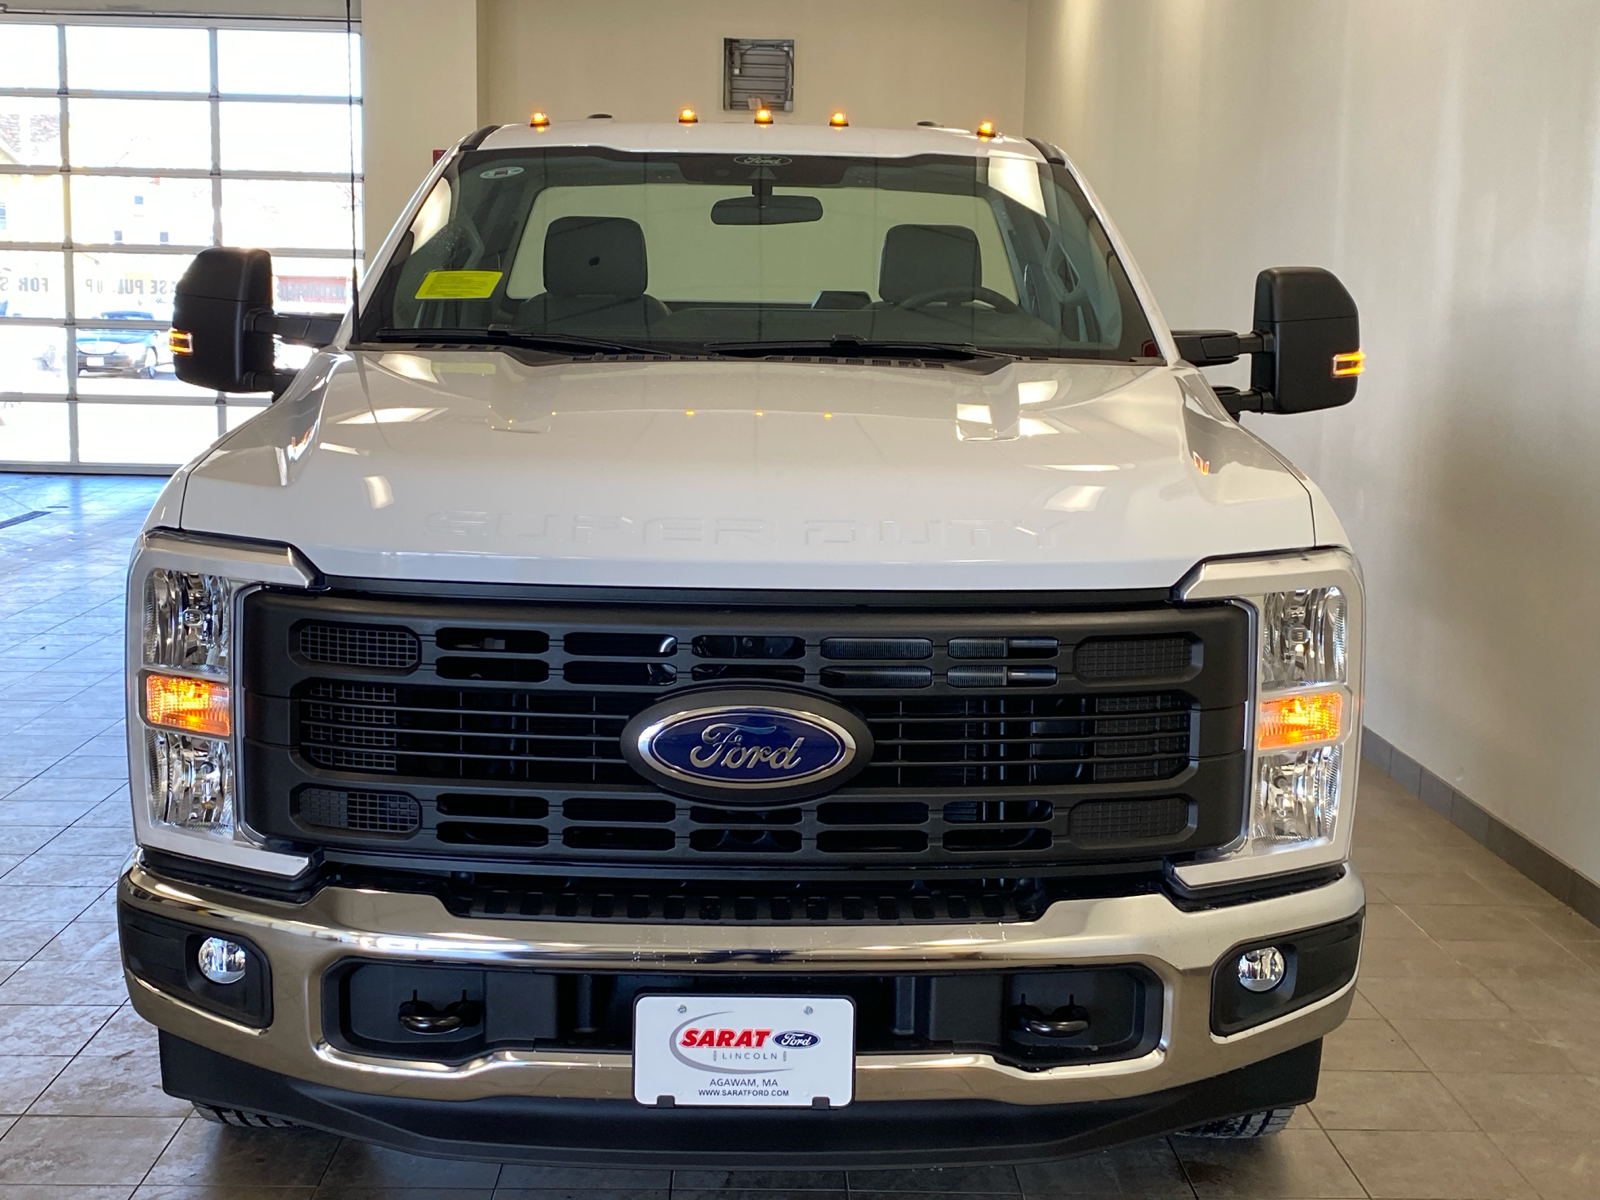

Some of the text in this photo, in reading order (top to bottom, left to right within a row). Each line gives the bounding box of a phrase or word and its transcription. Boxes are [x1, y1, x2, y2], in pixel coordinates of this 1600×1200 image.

[423, 510, 1074, 549] SUPER DUTY
[689, 722, 806, 770] Ford
[680, 1028, 812, 1048] SARAT Ford
[722, 1052, 778, 1060] LINCOLN
[709, 1078, 778, 1088] AGAWAM, MA
[698, 1089, 789, 1097] WWW.SARATFORD.COM
